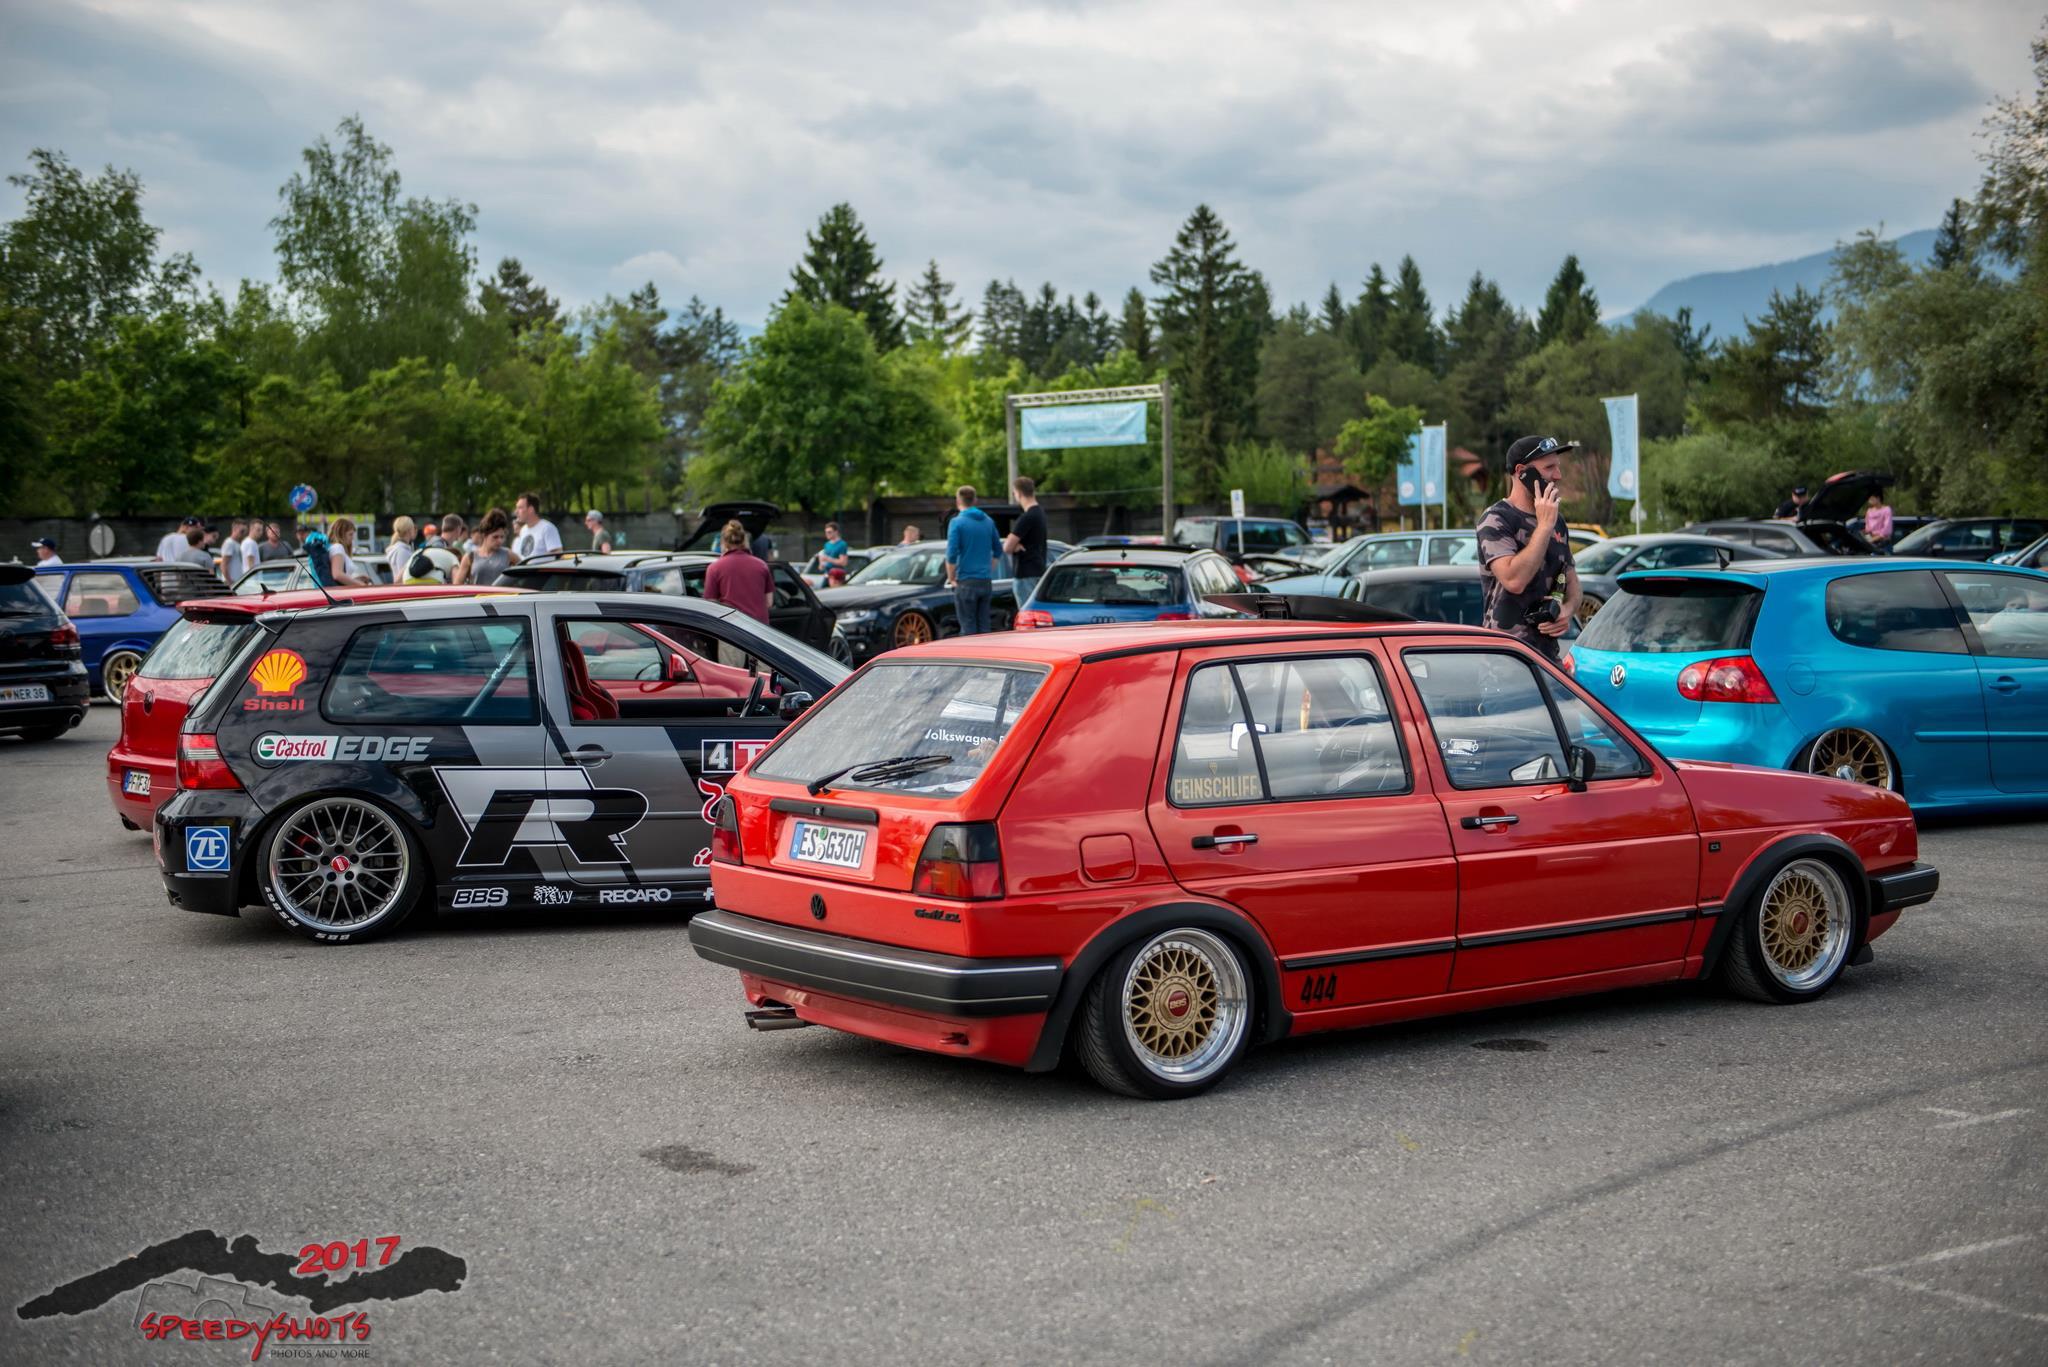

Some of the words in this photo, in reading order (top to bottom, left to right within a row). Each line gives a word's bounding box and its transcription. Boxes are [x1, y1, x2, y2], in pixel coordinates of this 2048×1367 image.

[243, 698, 305, 711] Shell
[275, 738, 328, 758] Castrol
[334, 736, 434, 762] EDGE
[1174, 775, 1258, 800] FEINSCHLIFF
[191, 836, 225, 860] ZF
[799, 827, 819, 857] ES
[826, 831, 864, 864] G30H
[452, 888, 508, 908] BBS
[538, 888, 573, 905] KW
[600, 888, 672, 904] RECARO
[1301, 973, 1338, 1004] 444
